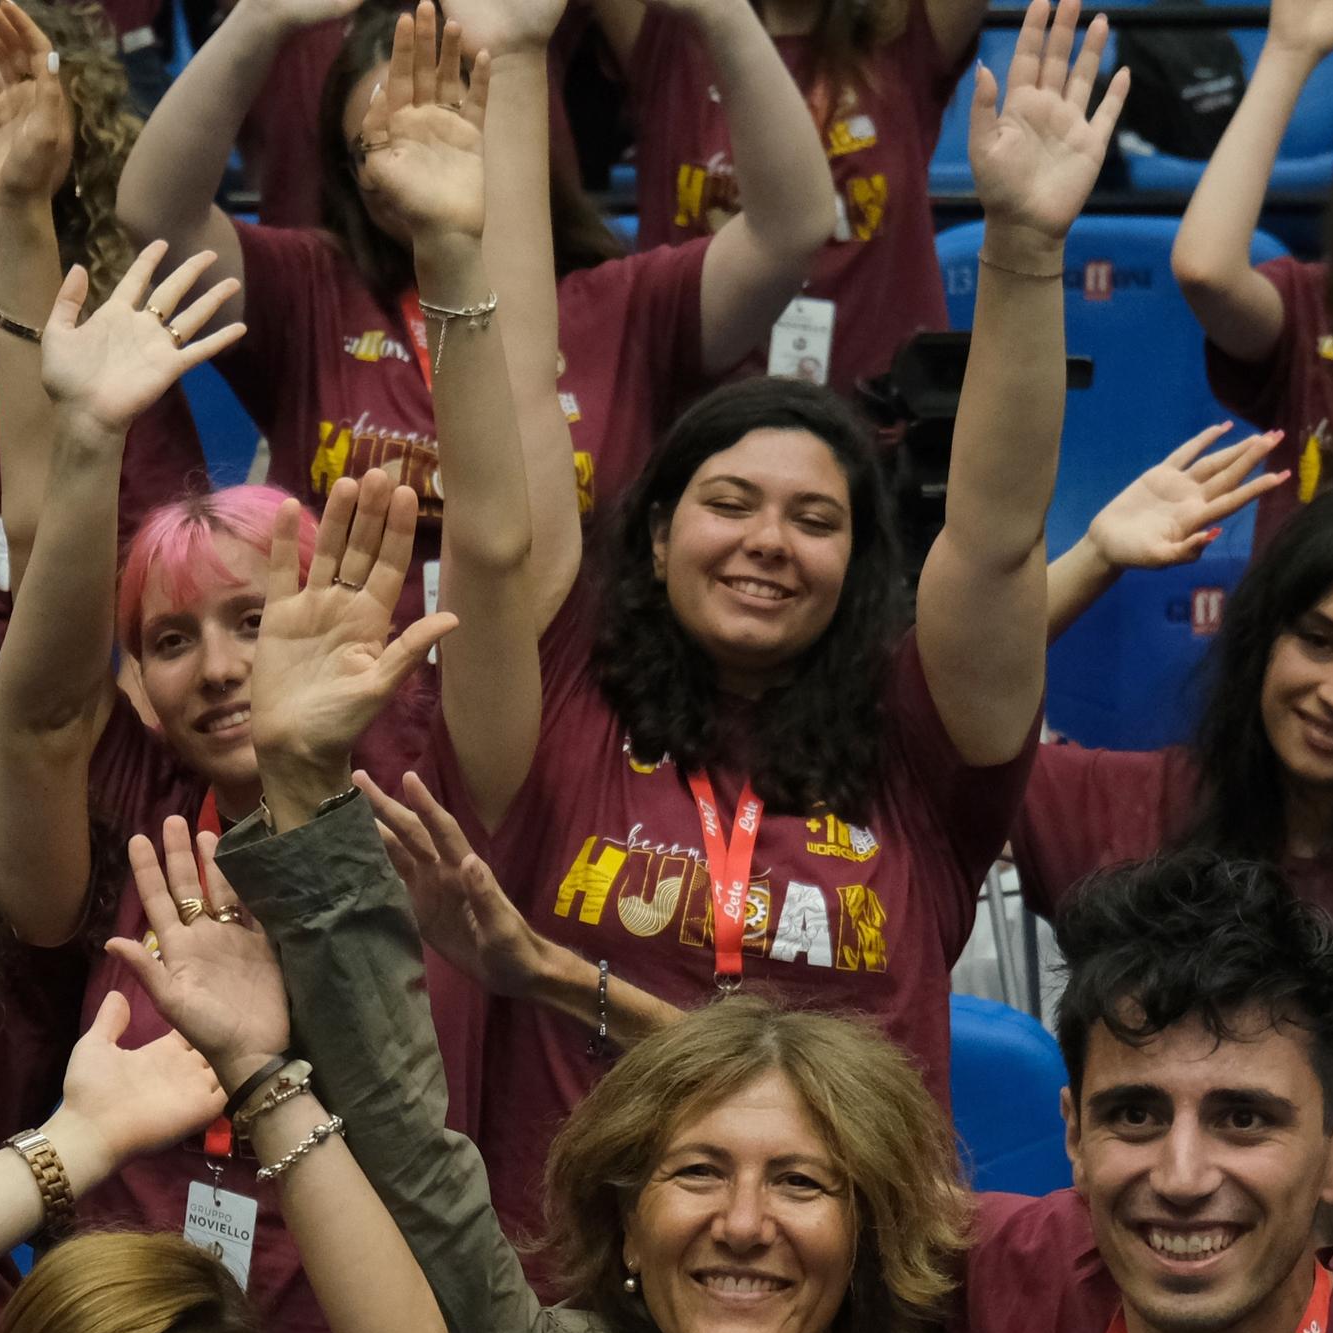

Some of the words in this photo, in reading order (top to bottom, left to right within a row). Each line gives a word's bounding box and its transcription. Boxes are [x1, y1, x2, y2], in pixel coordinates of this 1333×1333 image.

[724, 880, 743, 924] Lete
[190, 1203, 232, 1223] GRUPPO
[188, 1214, 250, 1241] NOVIELLO
